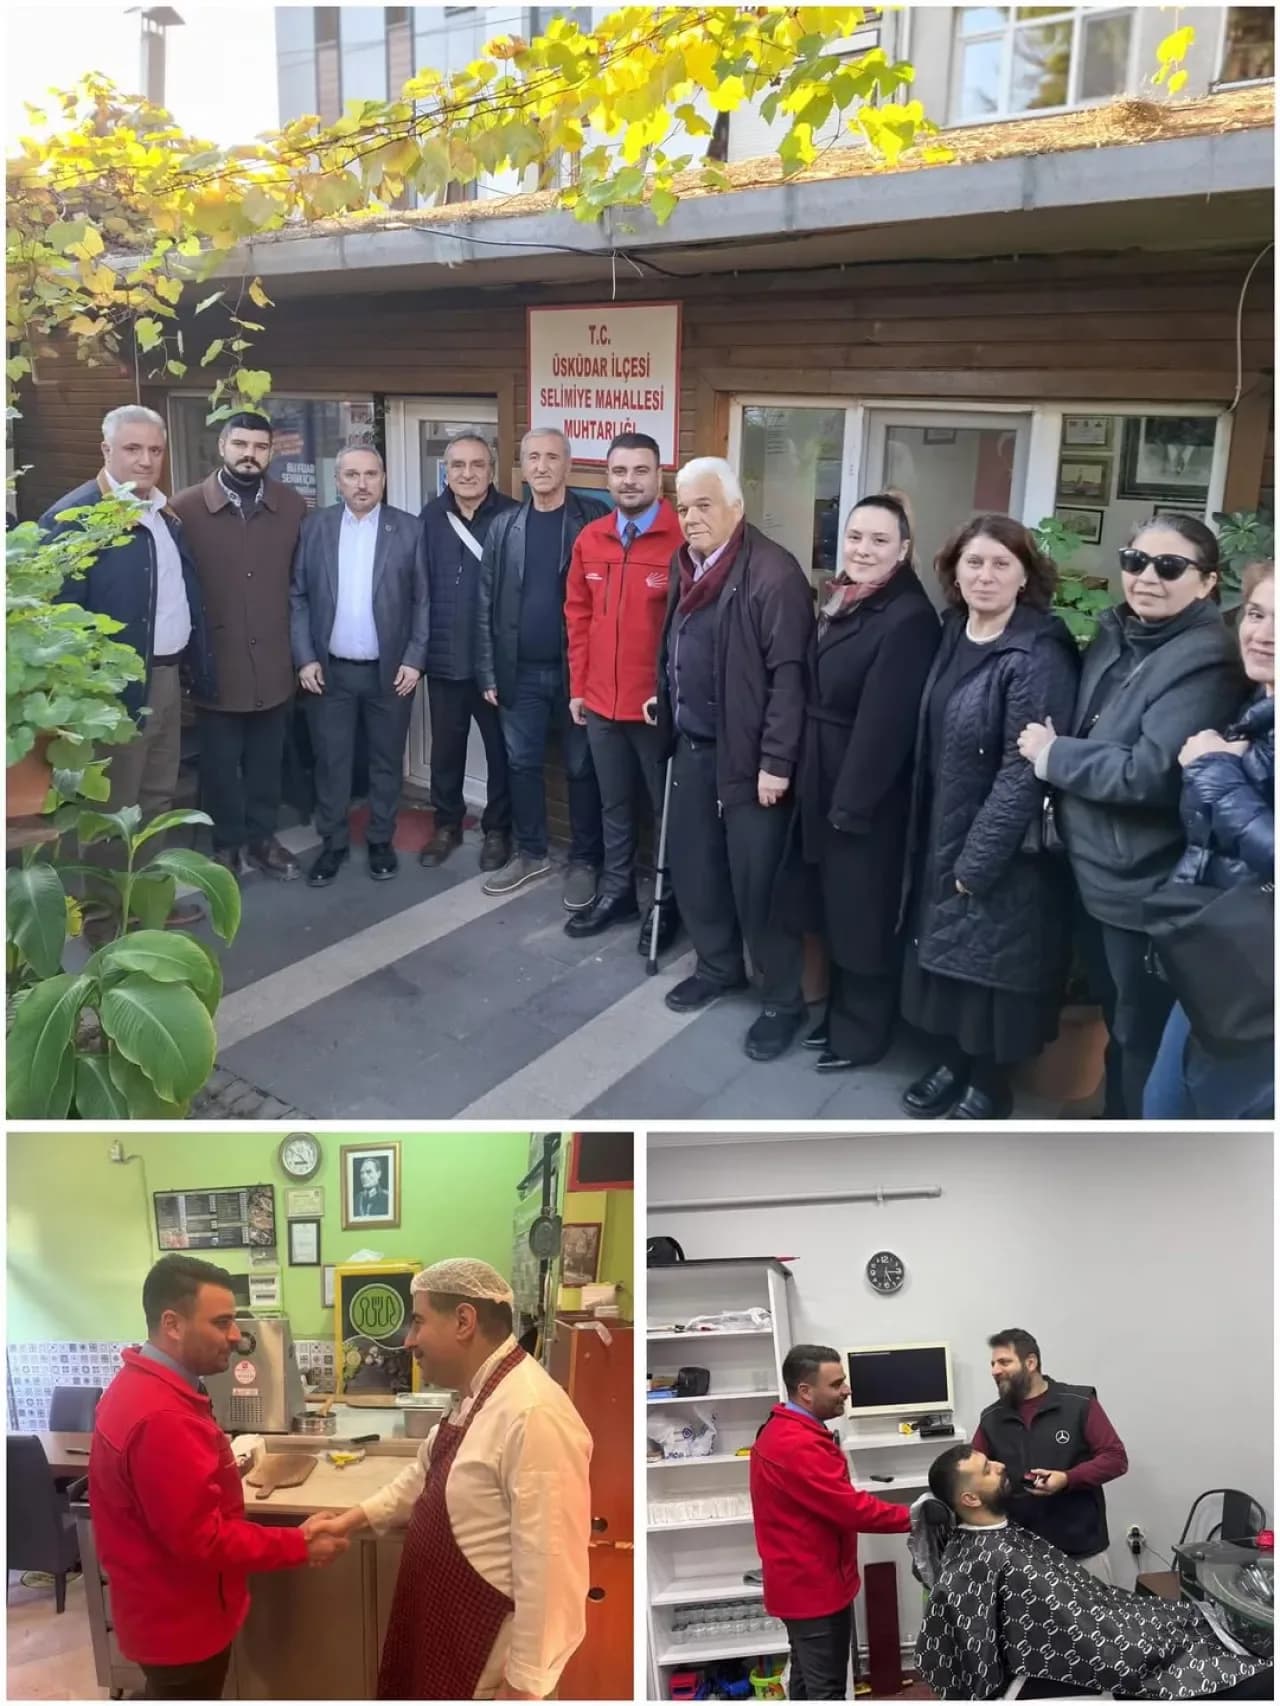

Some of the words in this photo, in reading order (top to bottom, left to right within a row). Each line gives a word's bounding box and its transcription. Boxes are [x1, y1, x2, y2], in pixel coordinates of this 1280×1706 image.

[588, 325, 611, 345] T.C.
[552, 353, 608, 377] ÜSKÜDAR
[611, 352, 650, 383] İLÇESİ
[540, 384, 592, 409] SELİMİYE
[595, 385, 664, 411] MAHALLESİ
